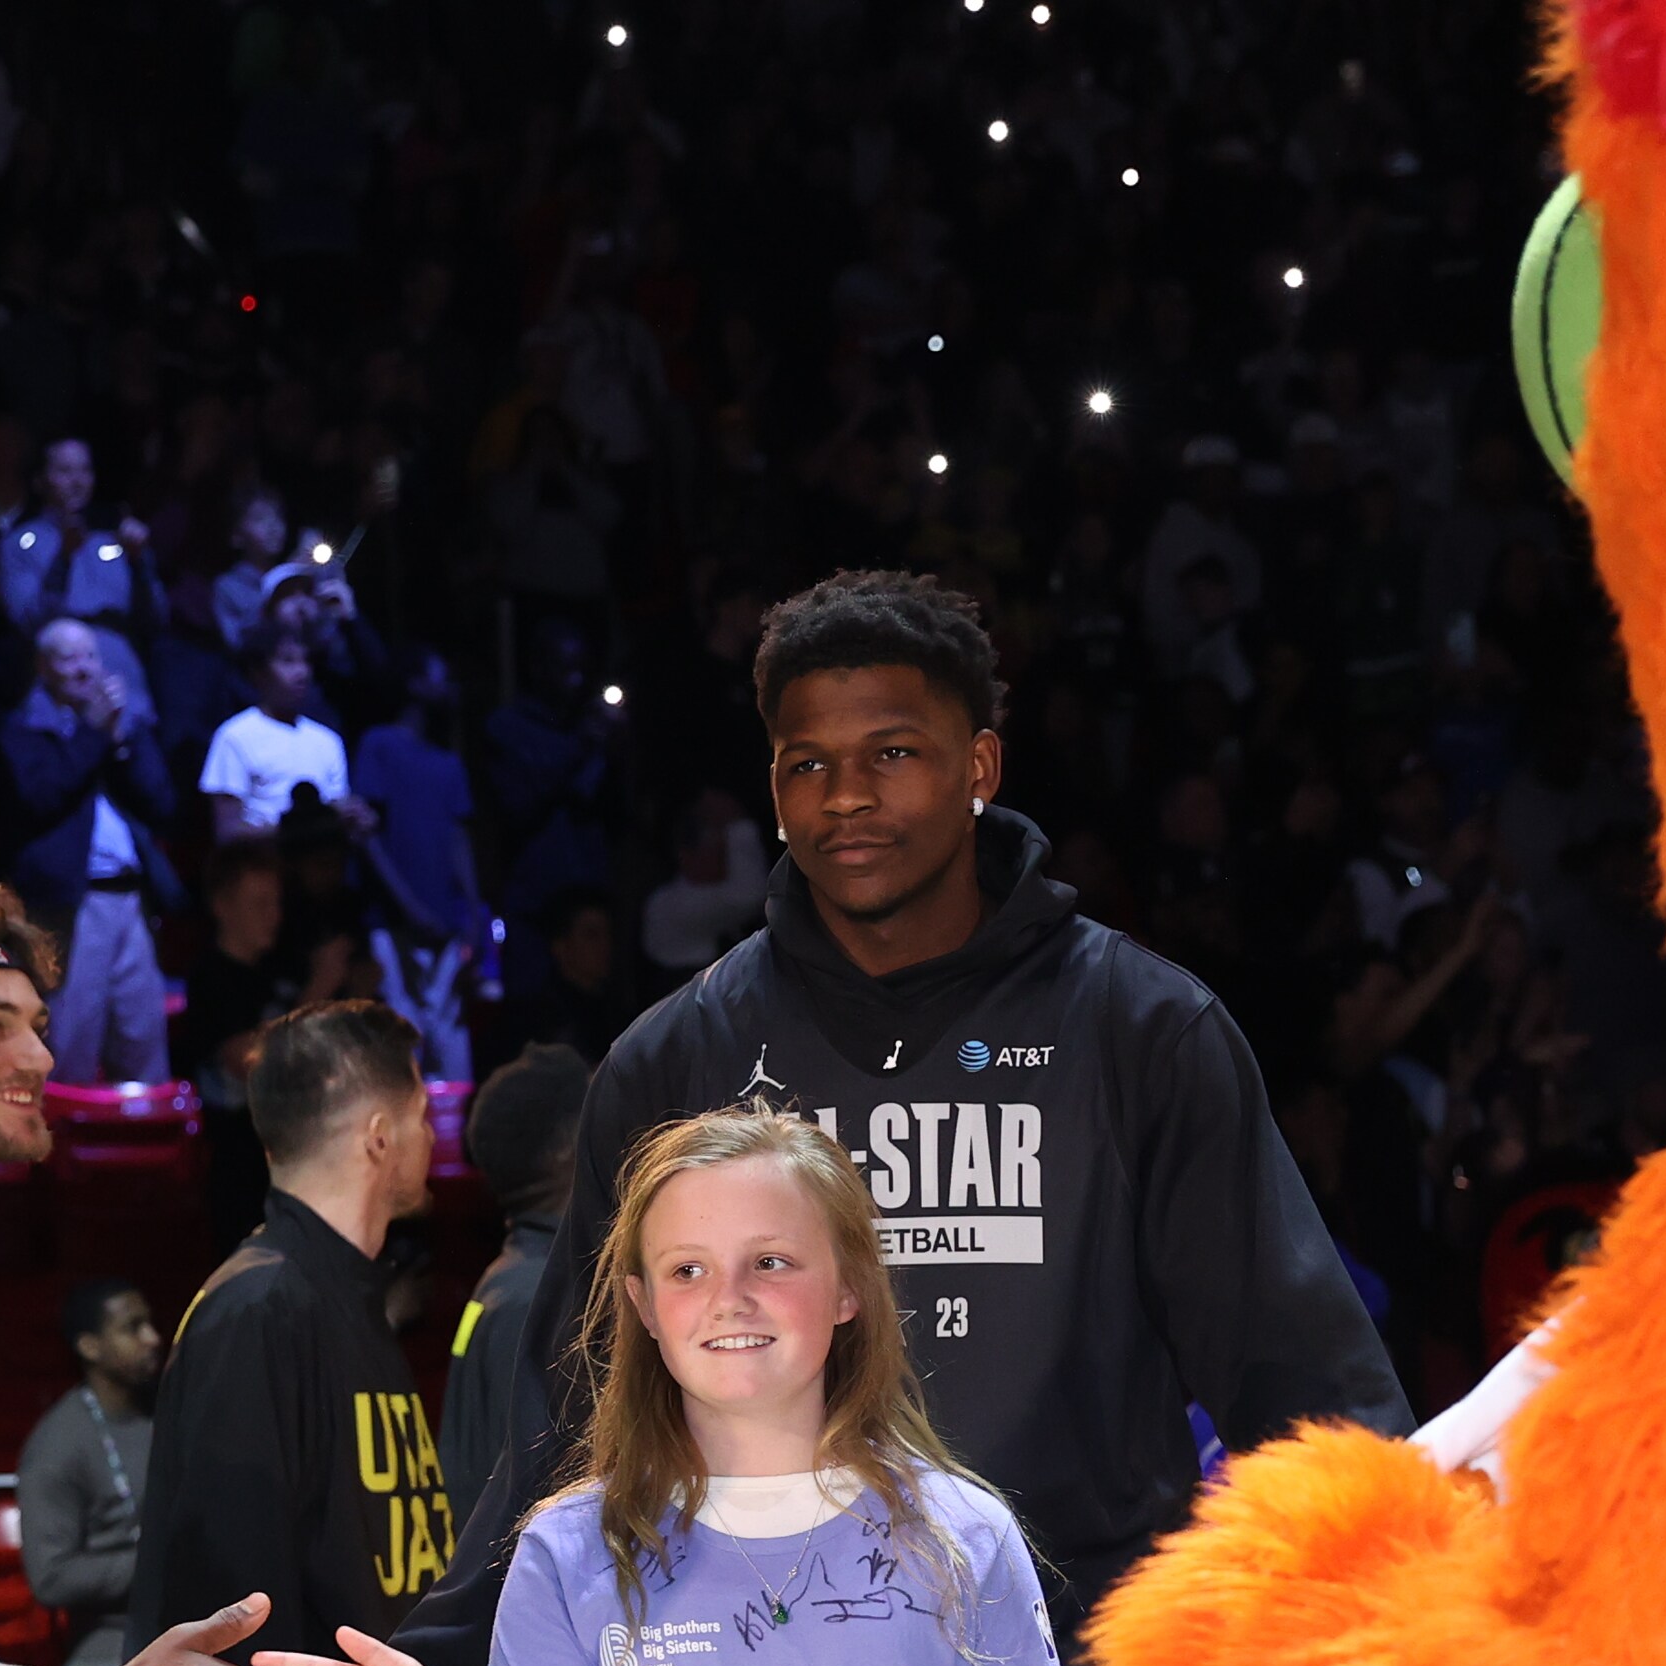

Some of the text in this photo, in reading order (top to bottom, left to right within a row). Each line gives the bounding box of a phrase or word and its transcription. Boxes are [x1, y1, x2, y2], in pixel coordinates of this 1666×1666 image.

[995, 1046, 1055, 1067] AT&T
[774, 1102, 1043, 1209] -STAR
[935, 1296, 969, 1338] 23
[640, 1619, 721, 1642] Big Brothers
[642, 1640, 718, 1660] Big Sisters.
